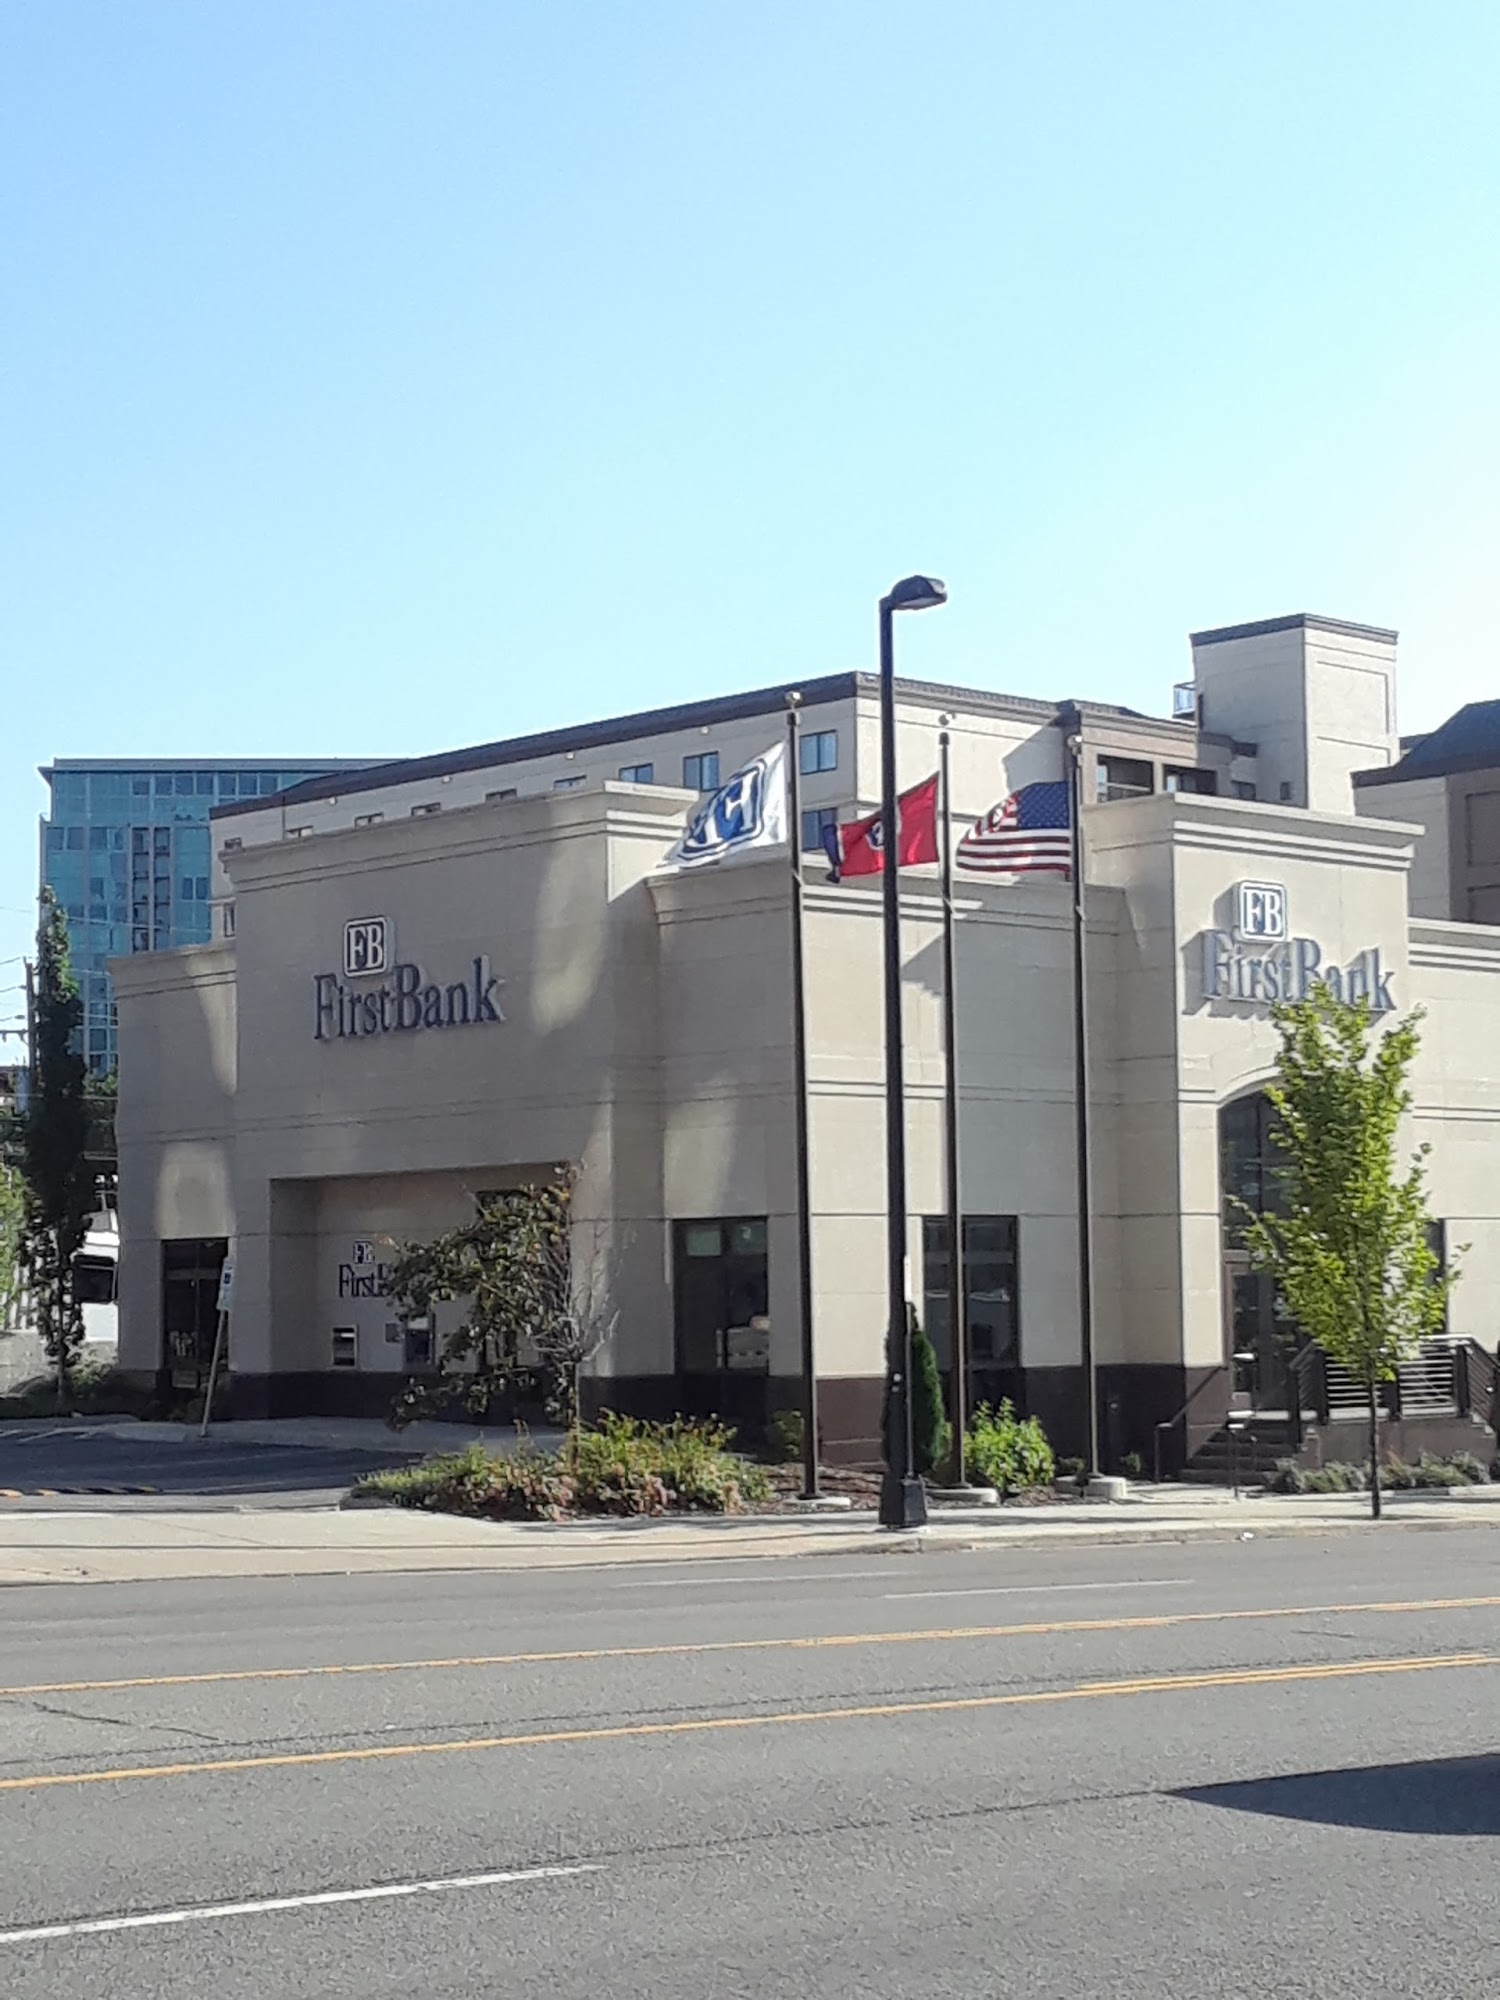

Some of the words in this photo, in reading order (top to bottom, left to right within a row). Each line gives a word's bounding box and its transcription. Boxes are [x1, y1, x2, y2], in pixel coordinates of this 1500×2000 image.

[1243, 888, 1283, 936] FB
[348, 923, 384, 971] FB
[1201, 929, 1397, 1011] FirstBank
[313, 955, 500, 1040] FirstBank
[339, 1263, 395, 1298] FirstB
